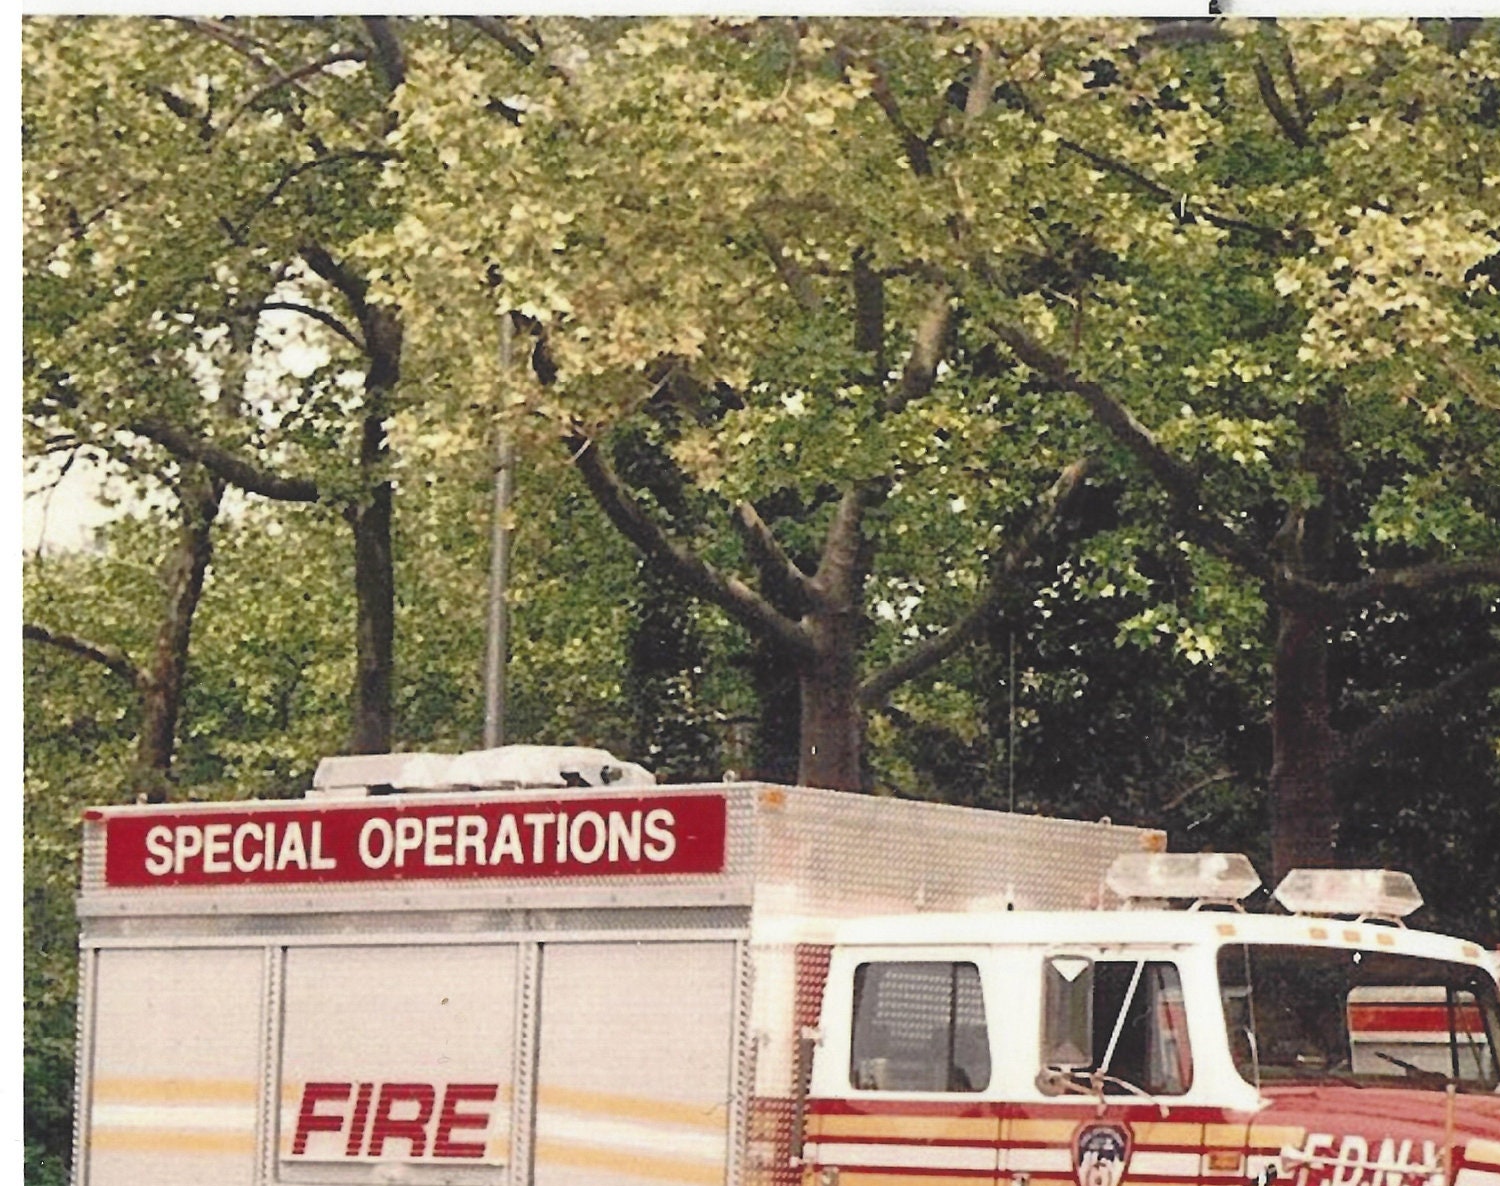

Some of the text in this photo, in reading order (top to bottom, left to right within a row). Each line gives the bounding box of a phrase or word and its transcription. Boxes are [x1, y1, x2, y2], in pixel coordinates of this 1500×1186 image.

[145, 808, 677, 876] SPECIAL OPERATIONS
[292, 1082, 499, 1158] FIRE
